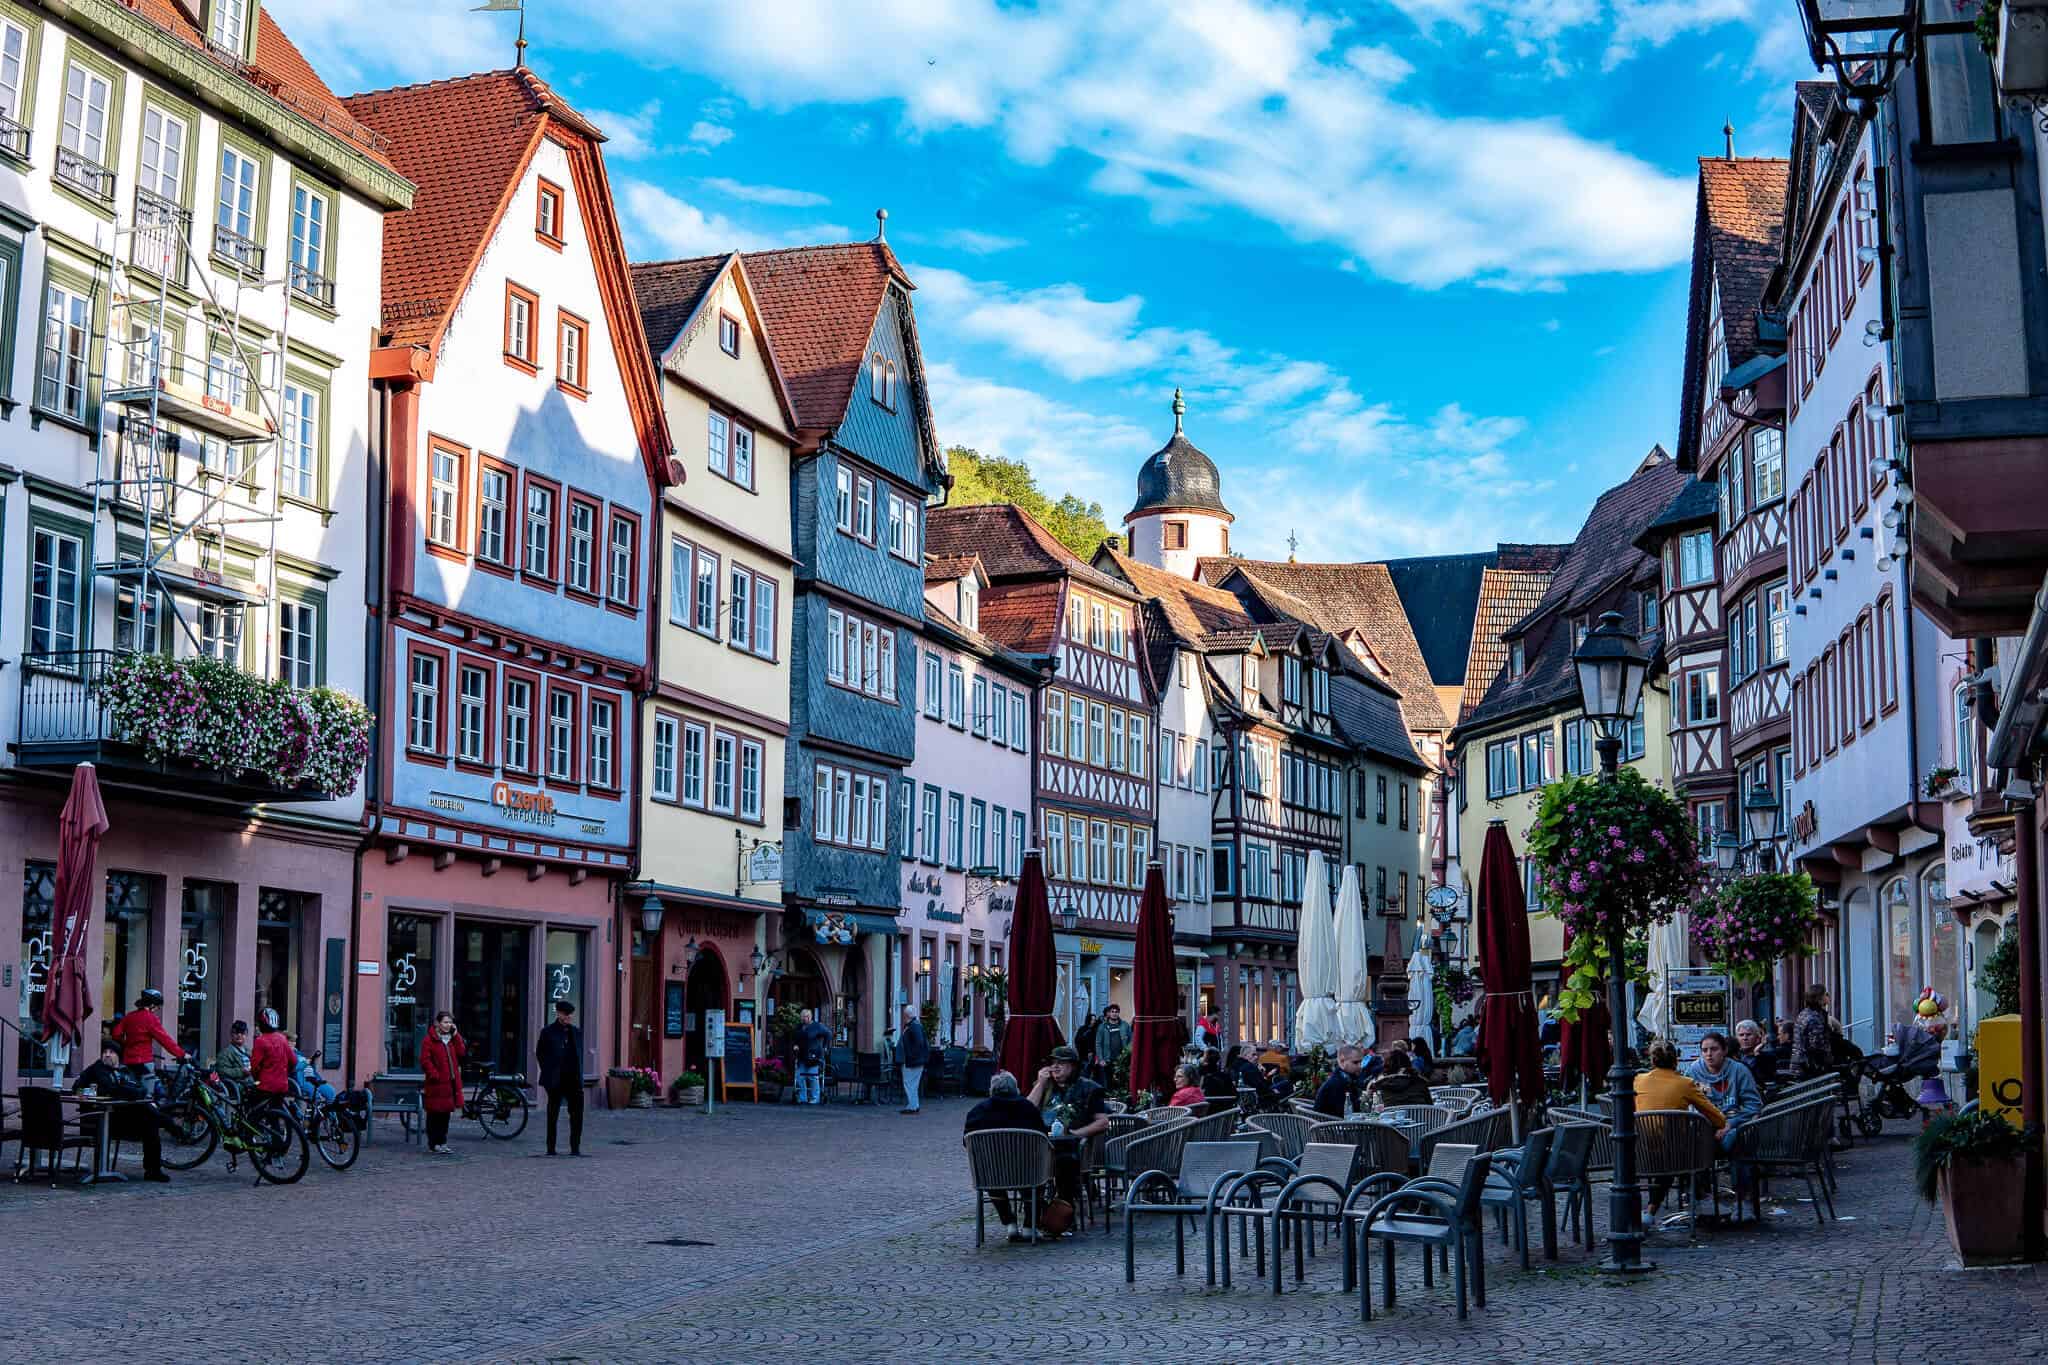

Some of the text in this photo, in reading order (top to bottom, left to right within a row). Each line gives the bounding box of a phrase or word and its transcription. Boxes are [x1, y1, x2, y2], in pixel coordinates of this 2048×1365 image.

[493, 782, 555, 814] akzente
[183, 943, 207, 985] 25
[395, 953, 416, 991] 25
[553, 965, 570, 998] 25
